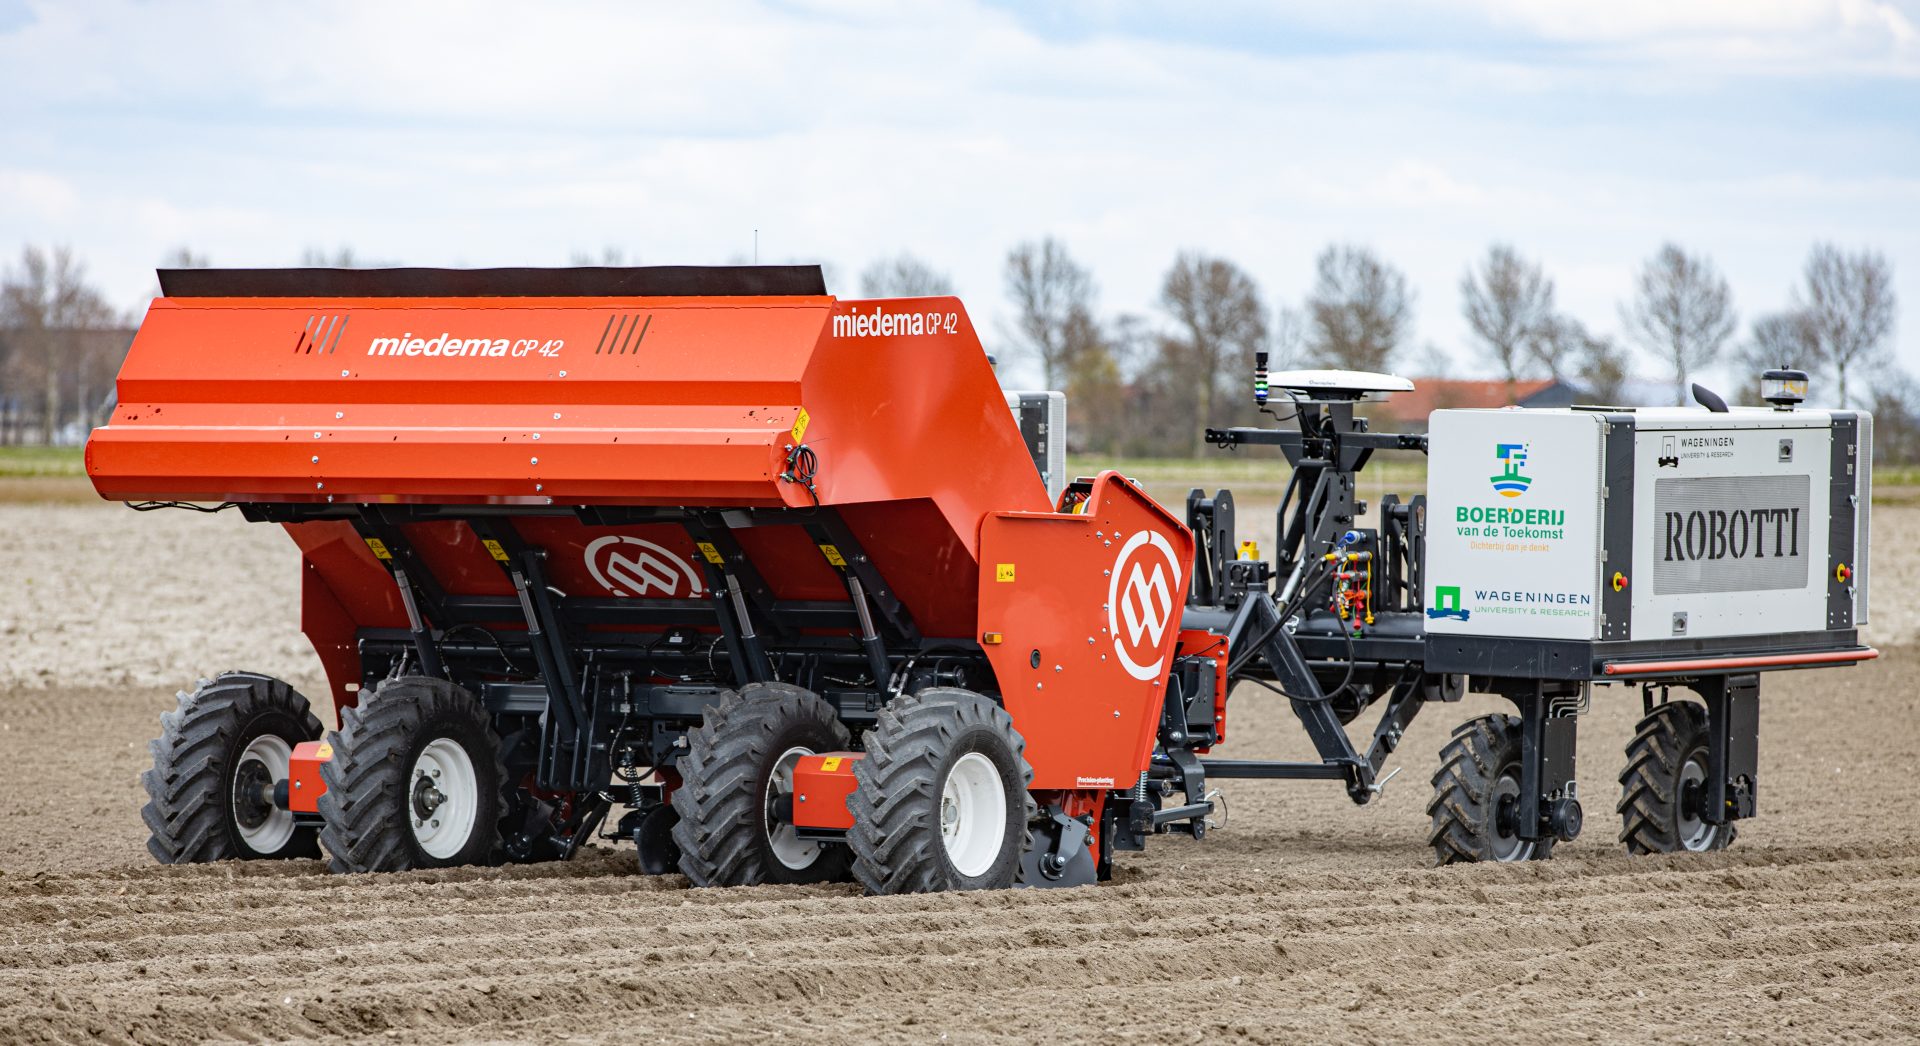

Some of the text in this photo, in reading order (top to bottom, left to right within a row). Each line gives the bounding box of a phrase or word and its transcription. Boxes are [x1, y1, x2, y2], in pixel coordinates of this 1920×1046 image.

[833, 306, 958, 338] miedema CP 42
[367, 332, 564, 357] miedema CP 42
[1681, 437, 1735, 447] WAGENINGEN
[1680, 451, 1705, 459] UNIVERSITY
[1456, 506, 1565, 526] BOERDERIJ
[1457, 525, 1564, 539] van de Toekomst
[1664, 507, 1800, 562] ROBOTTI
[1470, 541, 1549, 552] Dichterbij dan je denkt
[1475, 590, 1590, 605] WAGENINGEN
[1474, 606, 1528, 614] UNIVERSITY
[1540, 608, 1590, 617] RESEARCH
